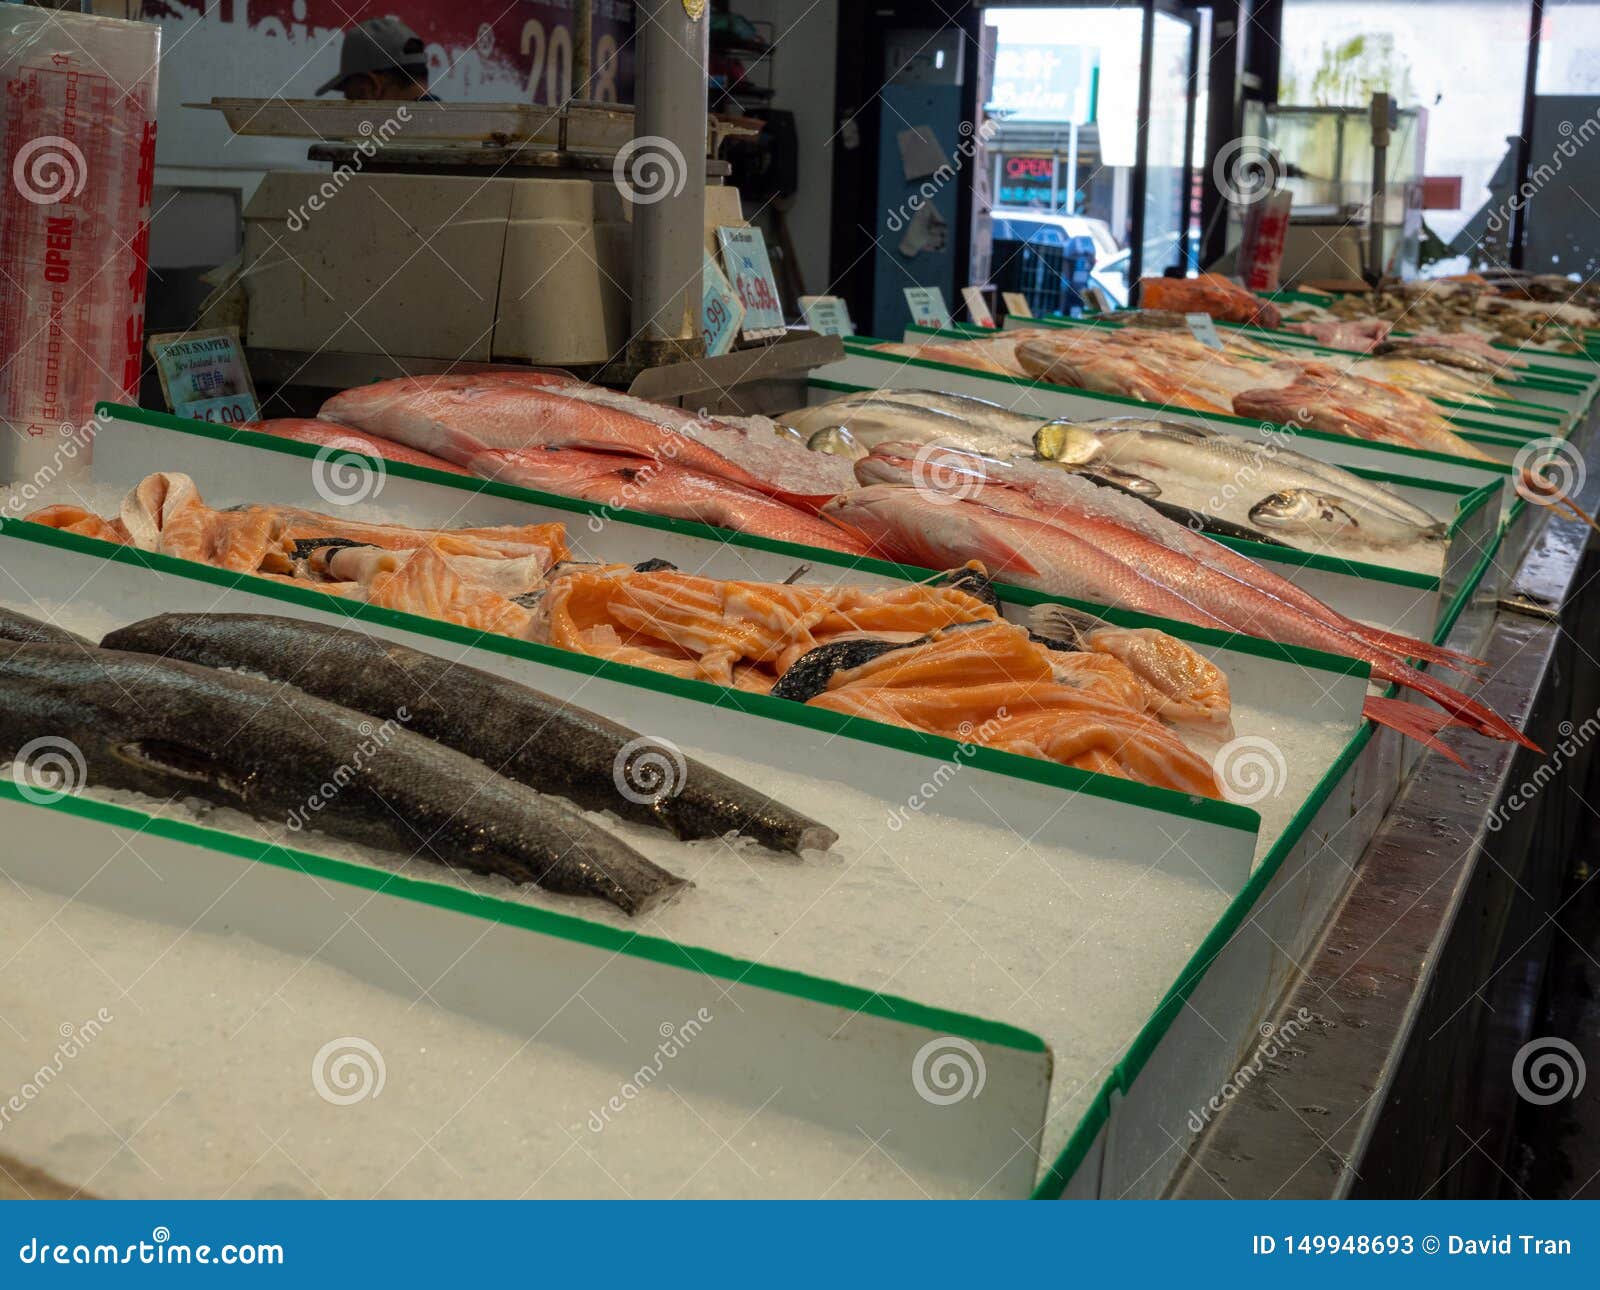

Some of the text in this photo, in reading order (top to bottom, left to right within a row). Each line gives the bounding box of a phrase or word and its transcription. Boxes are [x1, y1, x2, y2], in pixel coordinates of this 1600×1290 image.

[521, 19, 618, 106] 208
[1007, 157, 1054, 178] OPEN
[44, 217, 73, 284] OPEN
[193, 404, 245, 423] 699
